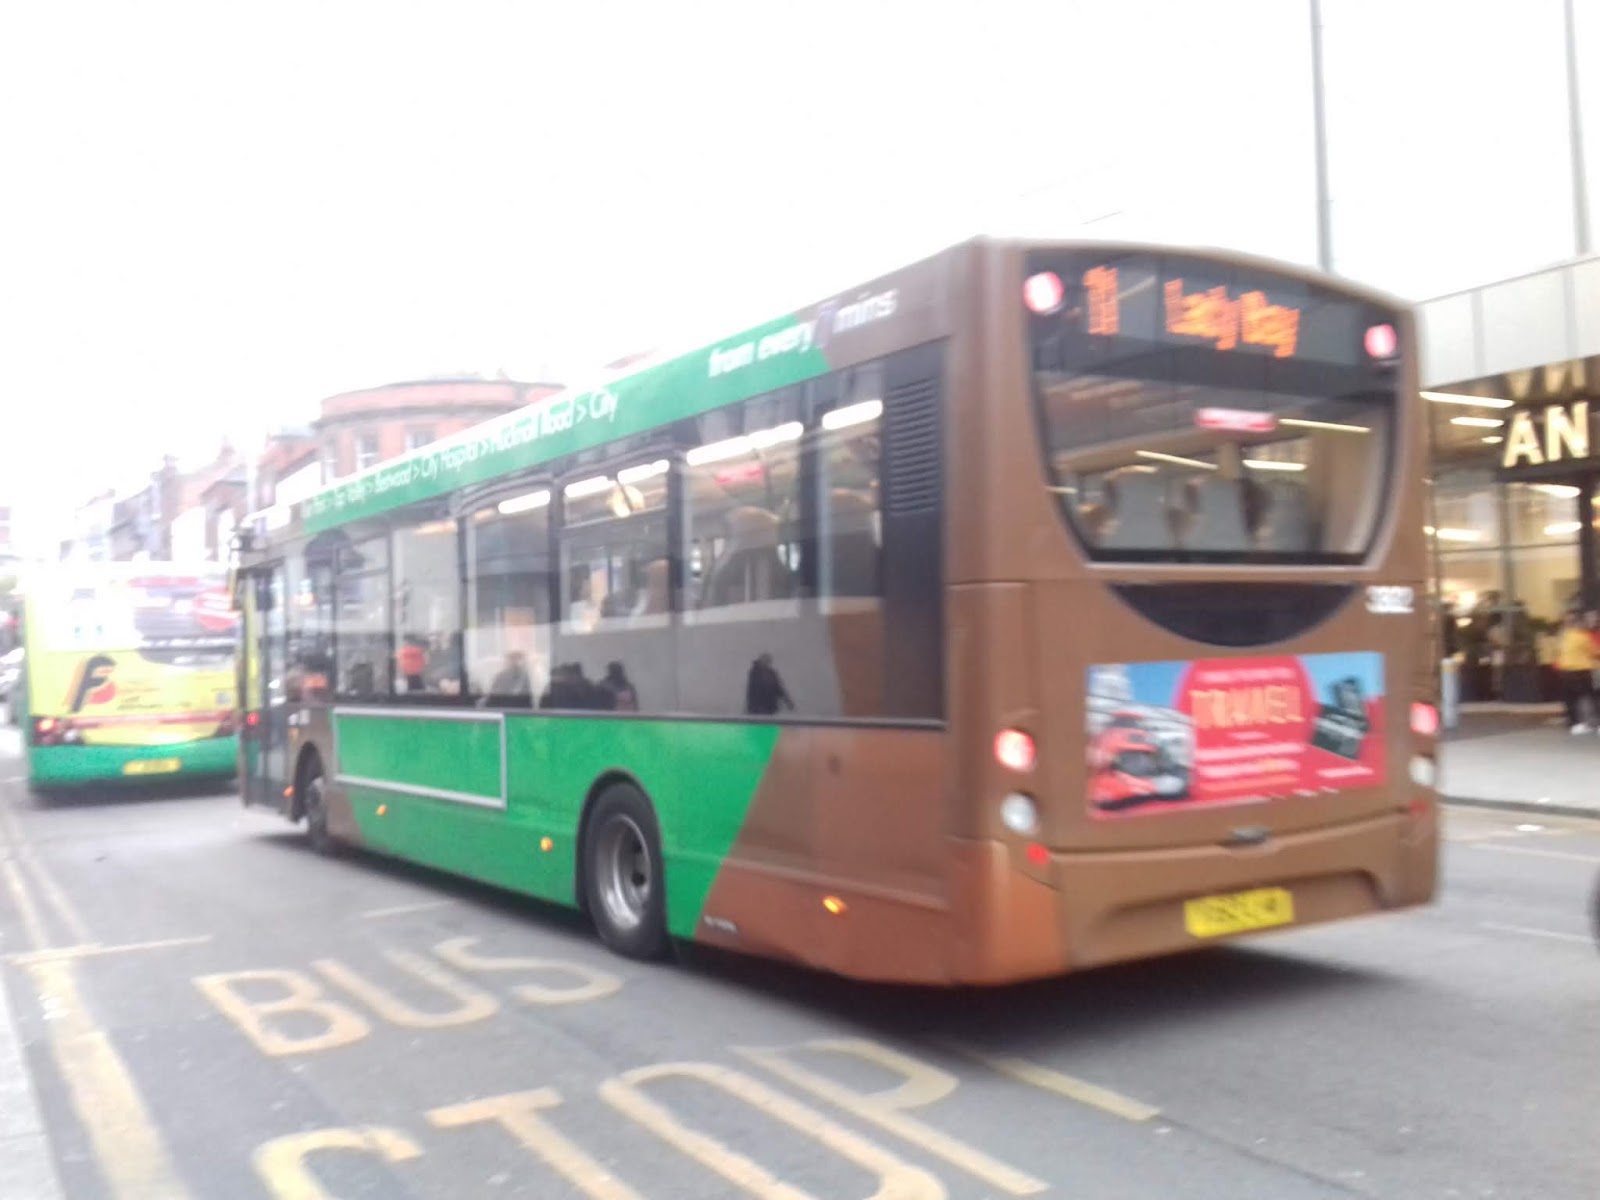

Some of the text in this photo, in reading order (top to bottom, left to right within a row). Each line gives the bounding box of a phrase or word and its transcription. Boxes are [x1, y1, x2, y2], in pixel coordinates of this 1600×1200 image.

[708, 345, 755, 379] from
[756, 322, 811, 360] every
[832, 288, 898, 334] mins
[1164, 278, 1238, 351] Lady
[1240, 290, 1299, 358] Bay
[589, 391, 619, 423] City
[193, 936, 622, 1057] BUS
